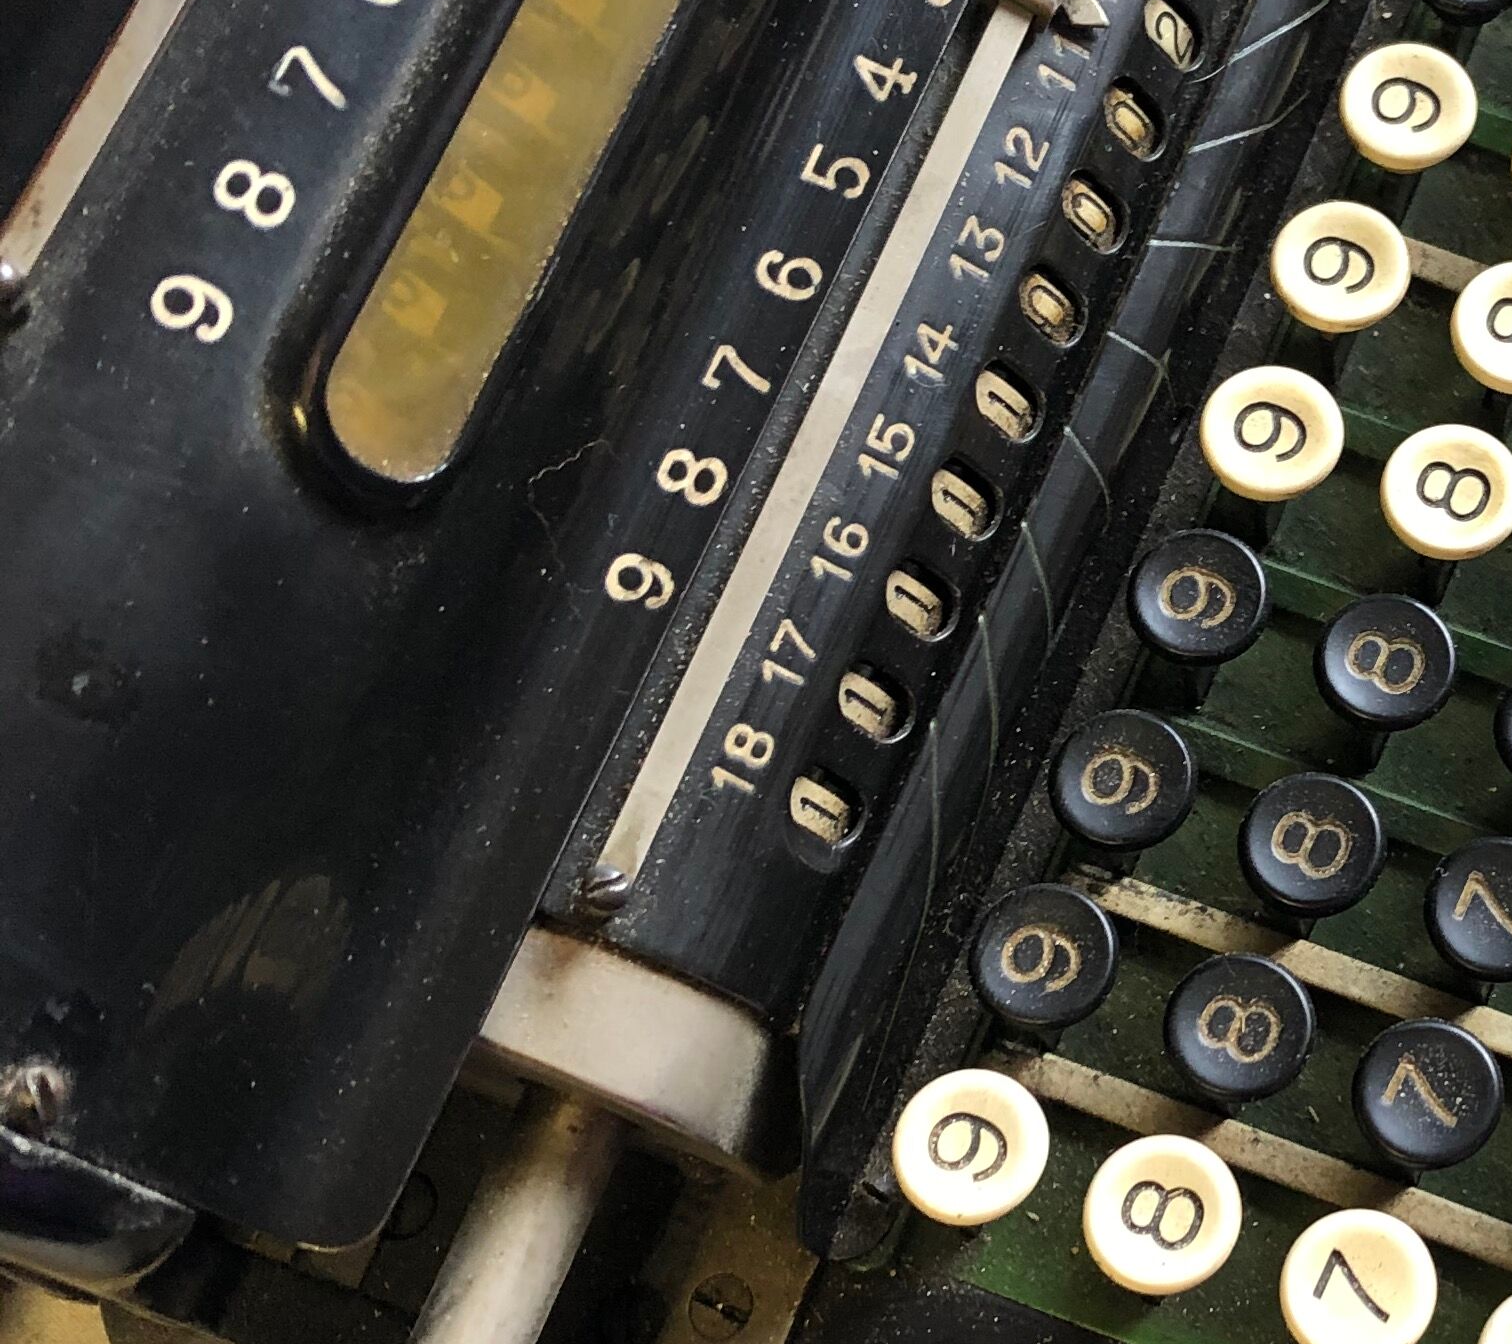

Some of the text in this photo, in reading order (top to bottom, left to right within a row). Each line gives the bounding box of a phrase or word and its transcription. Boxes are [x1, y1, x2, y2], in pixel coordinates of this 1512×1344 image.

[1155, 11, 1195, 64] 2
[1372, 78, 1441, 133] 9
[149, 274, 234, 343] 9
[212, 159, 297, 230] 8
[268, 44, 349, 111] 7
[1303, 236, 1374, 294] 9
[603, 552, 676, 611] 9
[655, 447, 731, 506] 8
[701, 343, 774, 398] 7
[755, 249, 824, 303] 6
[800, 143, 872, 200] 5
[853, 53, 919, 103] 4
[710, 721, 777, 795] 18
[759, 617, 818, 688] 17
[808, 515, 872, 582] 16
[856, 413, 916, 481] 15
[902, 320, 960, 381] 14
[948, 213, 1007, 282] 13
[994, 124, 1052, 191] 12
[1235, 403, 1306, 462] 9
[1416, 461, 1490, 522] 8
[1158, 566, 1235, 629] 9
[1346, 630, 1427, 696] 8
[1081, 748, 1159, 814] 9
[1270, 810, 1353, 879] 8
[1001, 924, 1081, 992] 9
[1198, 995, 1281, 1065] 8
[1382, 1056, 1458, 1129] 7
[929, 1111, 1007, 1182] 9
[1121, 1180, 1204, 1250] 8
[1313, 1248, 1391, 1323] 7
